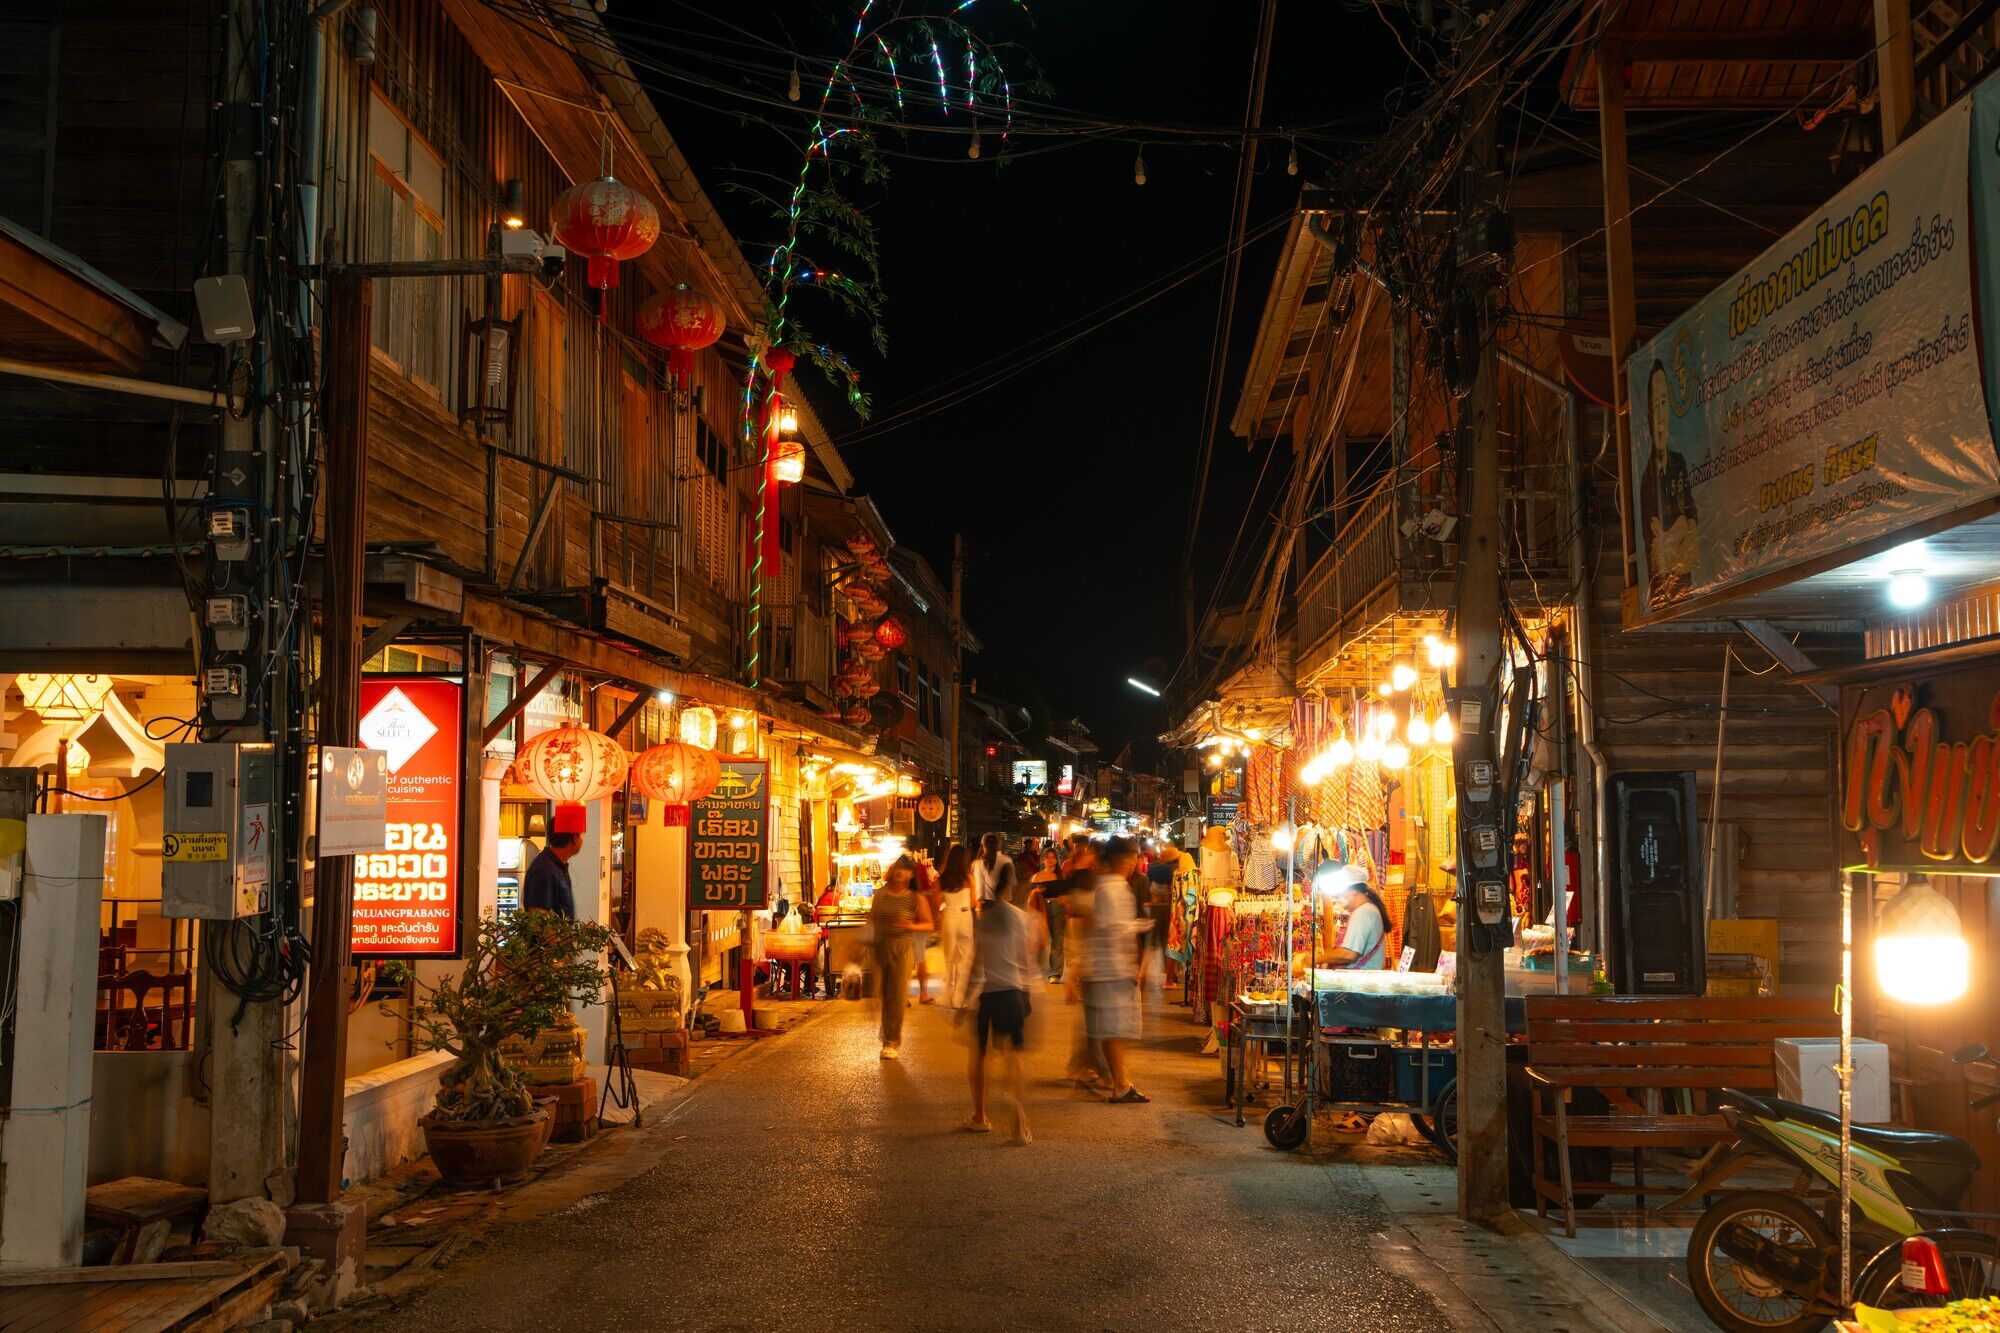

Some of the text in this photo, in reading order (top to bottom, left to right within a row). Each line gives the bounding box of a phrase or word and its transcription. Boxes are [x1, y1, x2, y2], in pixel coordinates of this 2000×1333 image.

[1729, 190, 1889, 341] เชียงคานโมเดล
[1580, 339, 1603, 350] true
[376, 729, 411, 737] SELECT
[386, 775, 453, 785] of authentic
[388, 785, 425, 794] cuisine
[354, 881, 448, 902] ระบาง
[381, 921, 440, 933] และต้นตำรับ
